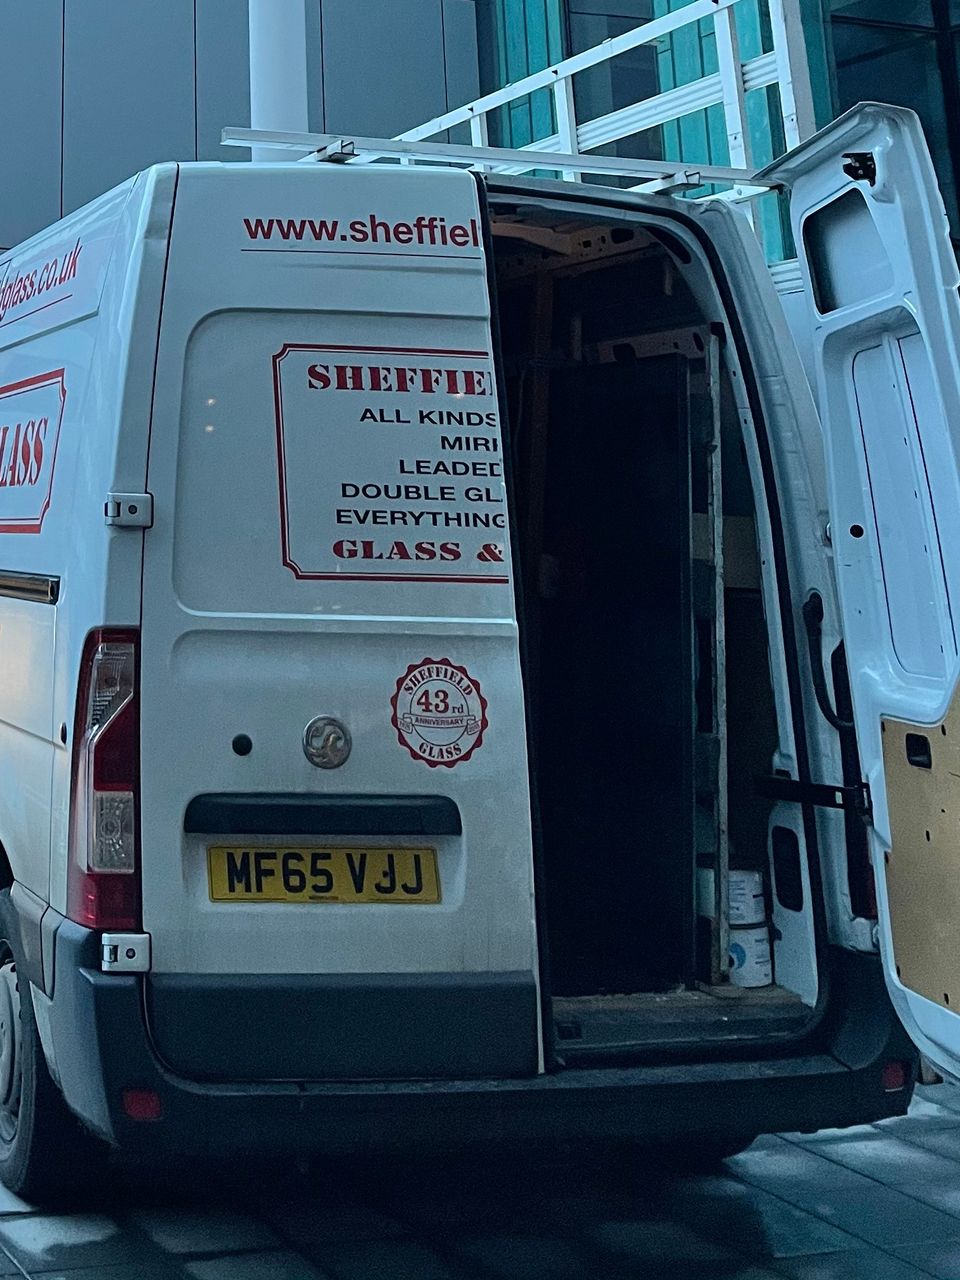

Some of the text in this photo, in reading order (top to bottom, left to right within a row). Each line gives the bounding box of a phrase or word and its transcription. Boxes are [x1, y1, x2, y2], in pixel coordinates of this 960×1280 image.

[308, 364, 493, 397] SHEFFIE
[359, 408, 497, 427] ALL KINDS
[341, 483, 504, 503] DOUBLE GL
[336, 509, 506, 529] EVERYTHING
[332, 539, 505, 562] GLASS &
[404, 666, 472, 696] SHEFFIELD
[415, 717, 464, 726] ANNIVERSARY
[418, 742, 462, 760] GLASS
[225, 851, 424, 895] MF65 VJJ
